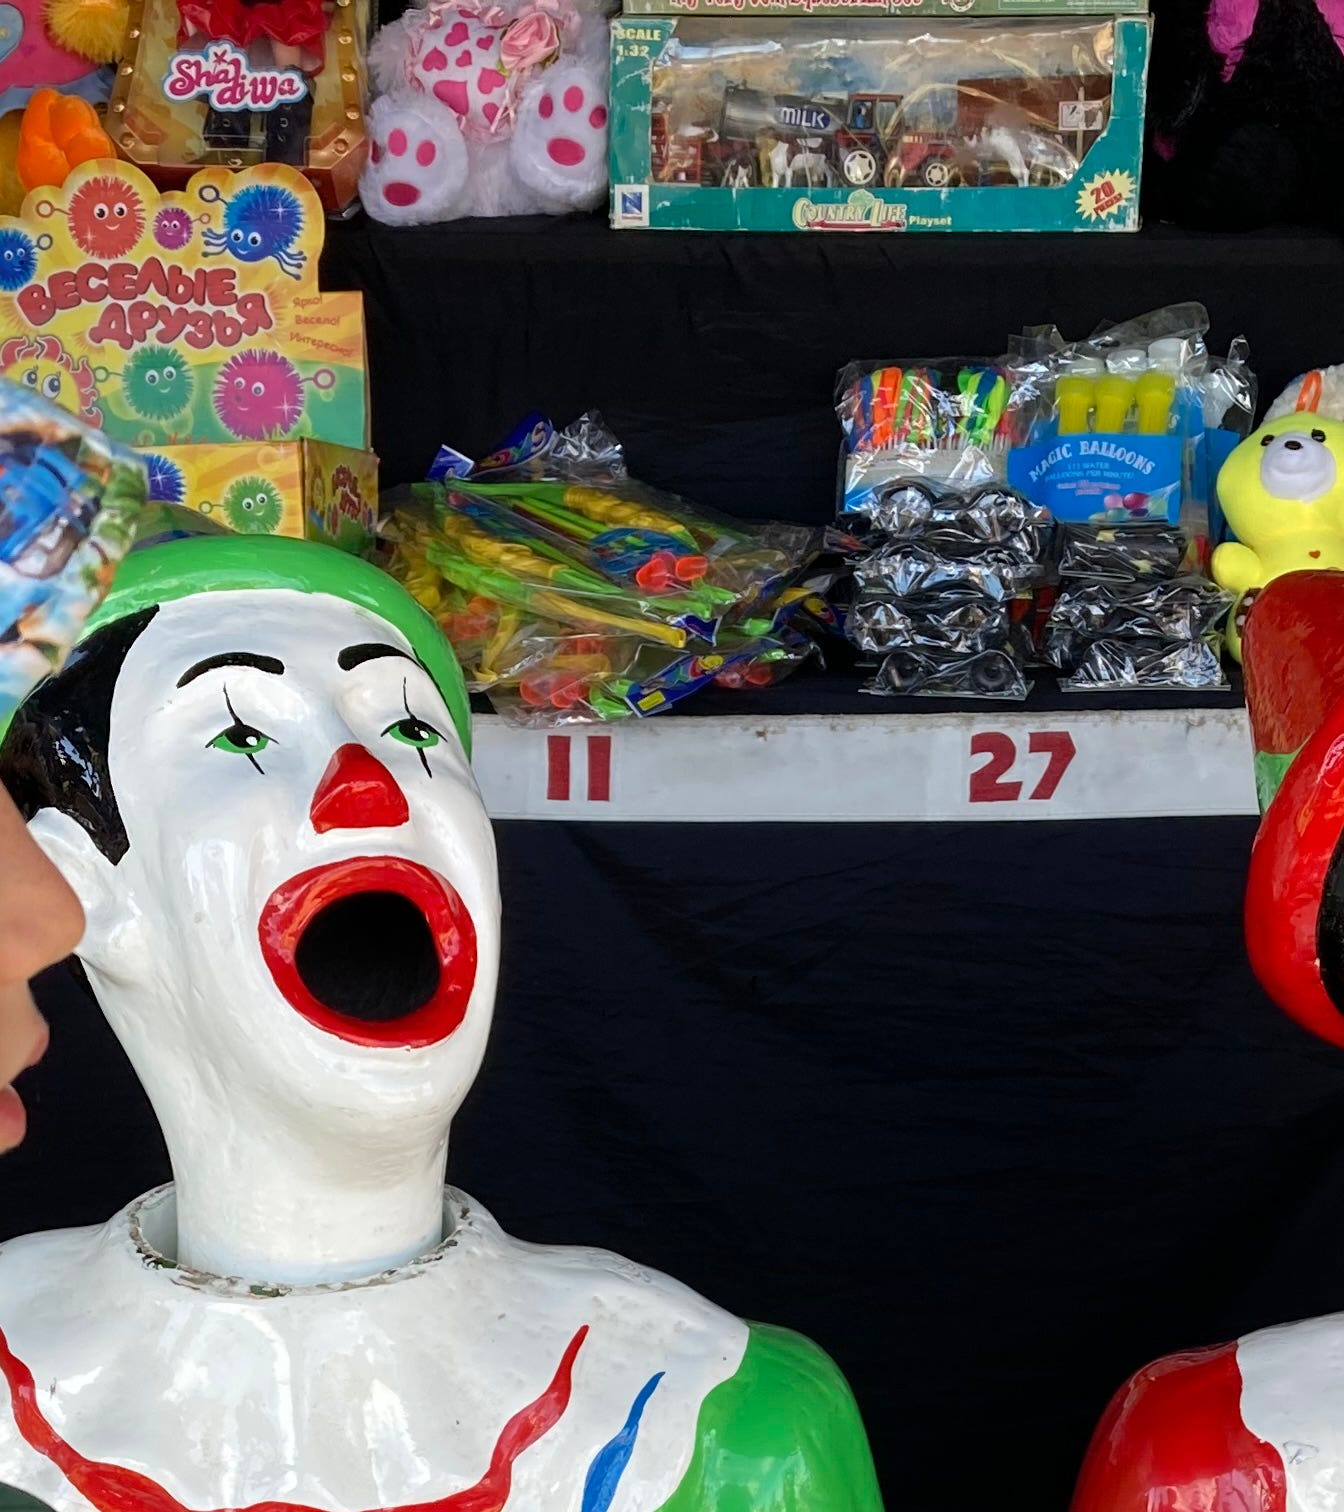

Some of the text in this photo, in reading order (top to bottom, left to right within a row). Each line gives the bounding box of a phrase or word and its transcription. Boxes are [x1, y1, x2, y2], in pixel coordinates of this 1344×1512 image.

[779, 106, 826, 129] MILK
[792, 197, 952, 230] COUNTRY LIFE Playset
[1090, 180, 1115, 205] 20
[16, 256, 238, 327] ВЕСЕЛЫЕ
[88, 292, 273, 350] ДРУЗЬЯ
[1028, 440, 1156, 483] MAGIC BALLOONS
[547, 735, 612, 801] 11
[968, 731, 1078, 803] 27
